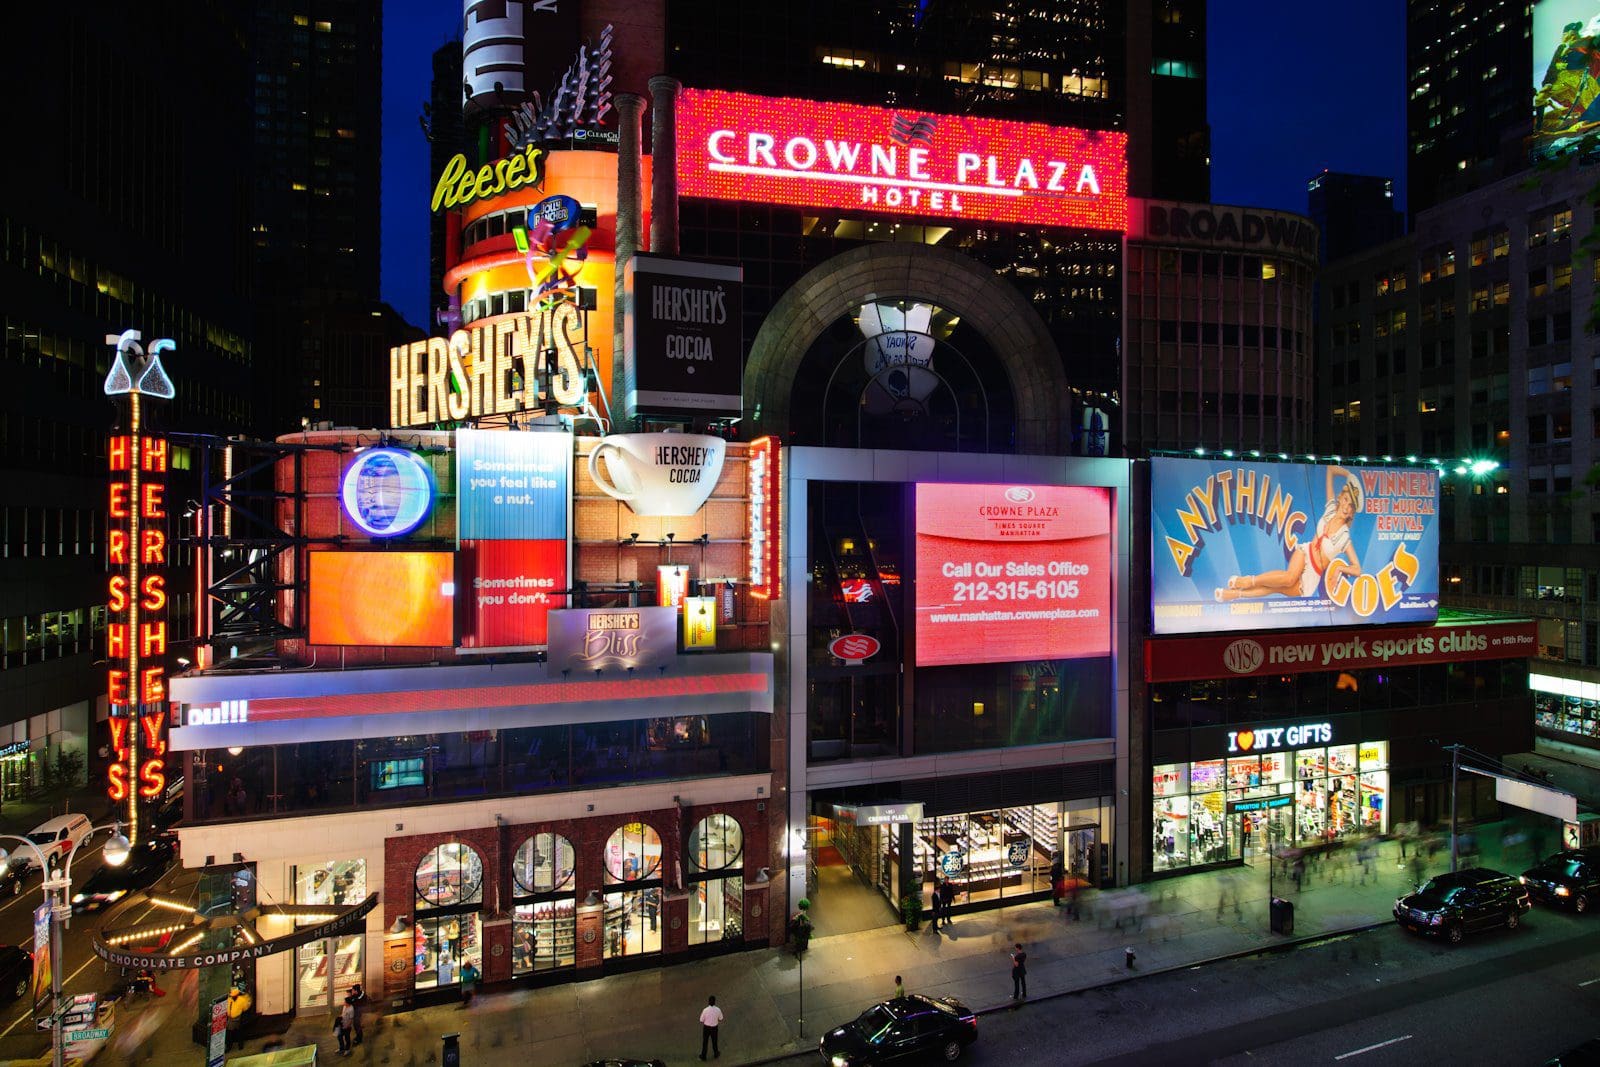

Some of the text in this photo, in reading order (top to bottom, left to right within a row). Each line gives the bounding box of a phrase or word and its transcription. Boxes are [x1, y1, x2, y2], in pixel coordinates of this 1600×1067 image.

[707, 129, 1100, 194] CROWNE PLAZA
[431, 144, 543, 212] Reese's
[541, 200, 561, 215] JOLLY
[862, 185, 963, 211] HOTEL
[652, 284, 727, 325] HERSHEY'S
[666, 334, 713, 361] COCOA
[389, 302, 585, 429] HERSHEY'S
[655, 446, 715, 467] HERSHEY'S
[470, 476, 557, 491] you feel like
[669, 468, 701, 483] COCOA
[1361, 469, 1436, 497] WINNER!
[493, 494, 534, 505] a nut.
[979, 506, 1059, 516] CROWNE PLAZA
[1365, 497, 1436, 515] BEST MUSICAL
[1165, 468, 1308, 577] ANYTHING
[1376, 515, 1424, 531] REVIVAL
[942, 561, 1089, 578] Call Our Sales Office
[1325, 541, 1420, 617] GOES
[473, 575, 555, 589] Sometimes
[953, 580, 1080, 601] 212-315-6105
[478, 592, 551, 609] you don't.
[108, 435, 131, 800] HERSHEY'S
[140, 435, 167, 797] HERSHEY'S
[589, 614, 639, 630] HERSHEY'S
[930, 607, 1099, 623] www.manhattan.crowneplaza.com
[582, 630, 646, 661] Bliss
[1228, 630, 1534, 671] NYSC new york sports clubs on 15th Floor
[1228, 722, 1332, 752] I NY GIFTS
[110, 941, 275, 968] CHOCOLATE COMPANY
[72, 1029, 107, 1042] BROADWAY
